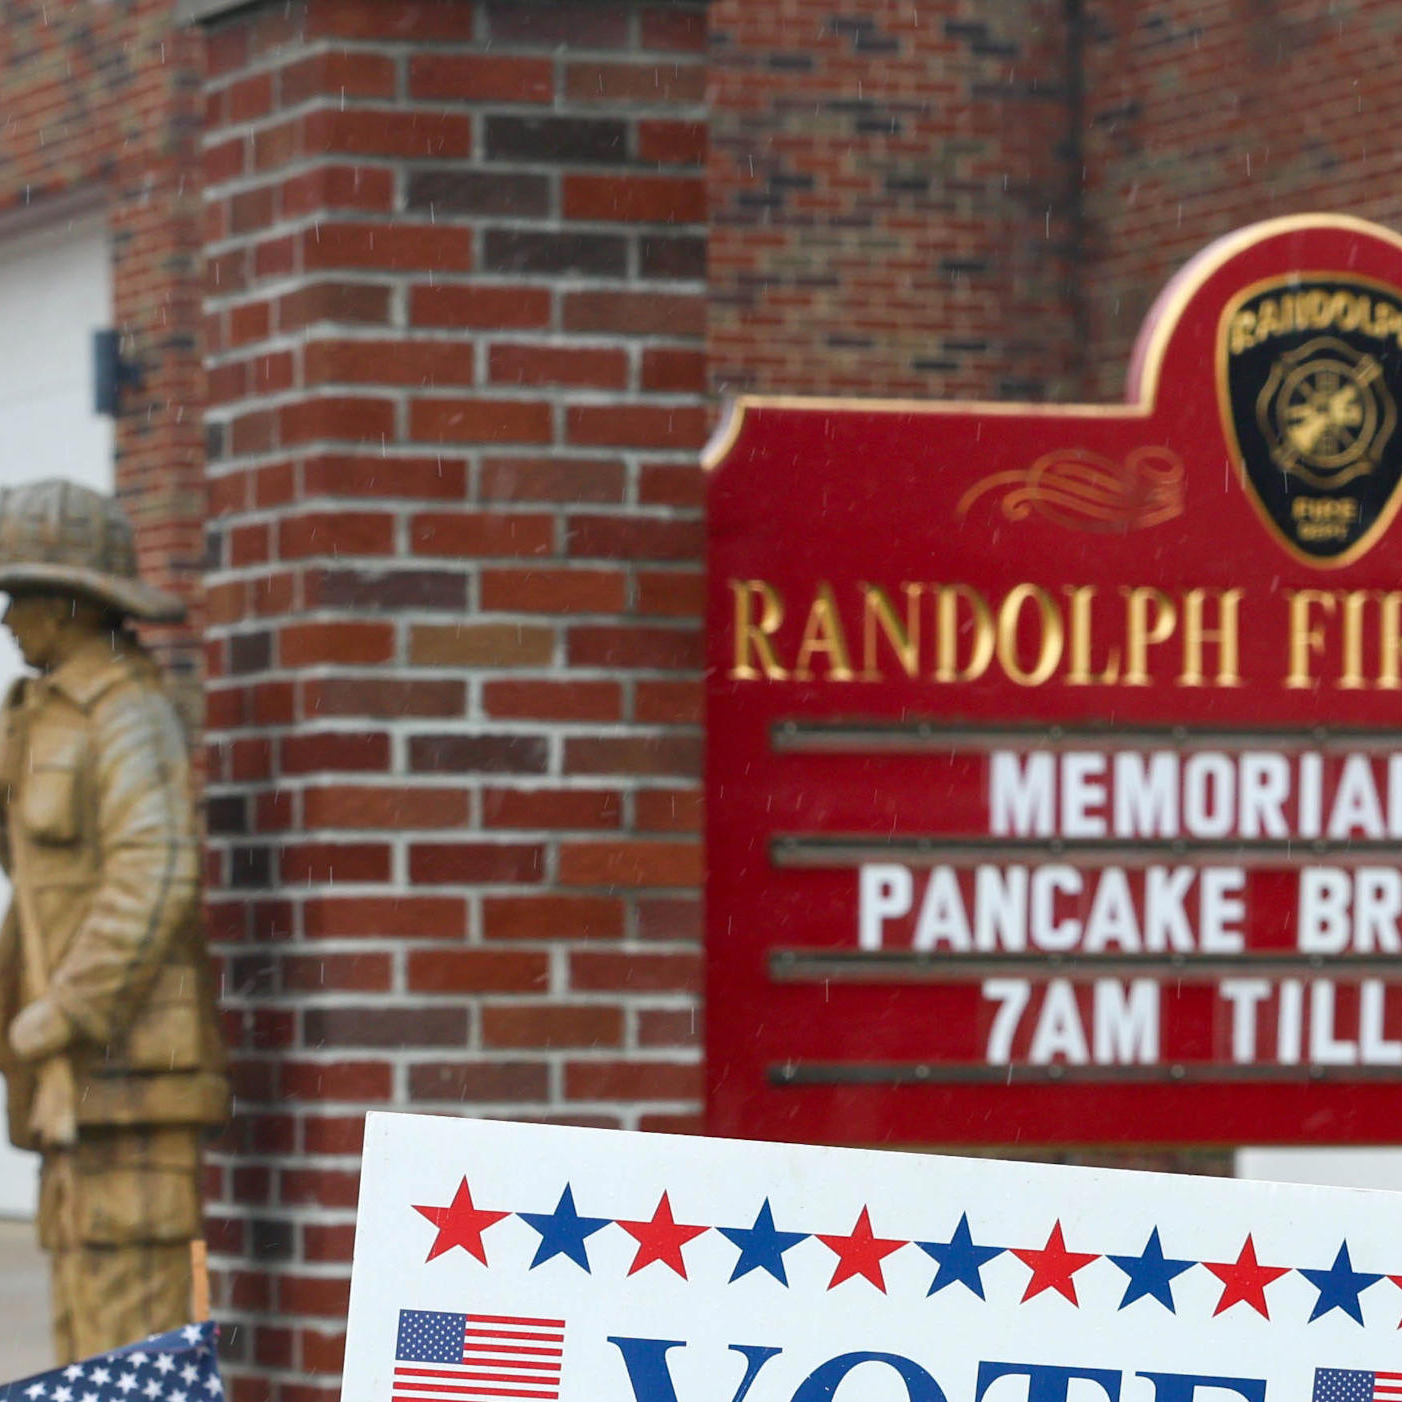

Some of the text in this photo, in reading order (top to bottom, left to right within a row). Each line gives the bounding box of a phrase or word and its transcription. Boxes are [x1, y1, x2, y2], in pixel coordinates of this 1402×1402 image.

[730, 580, 1243, 688] RANDOLPH
[859, 863, 1245, 954] PANCAKE
[982, 978, 1160, 1065] 7AM
